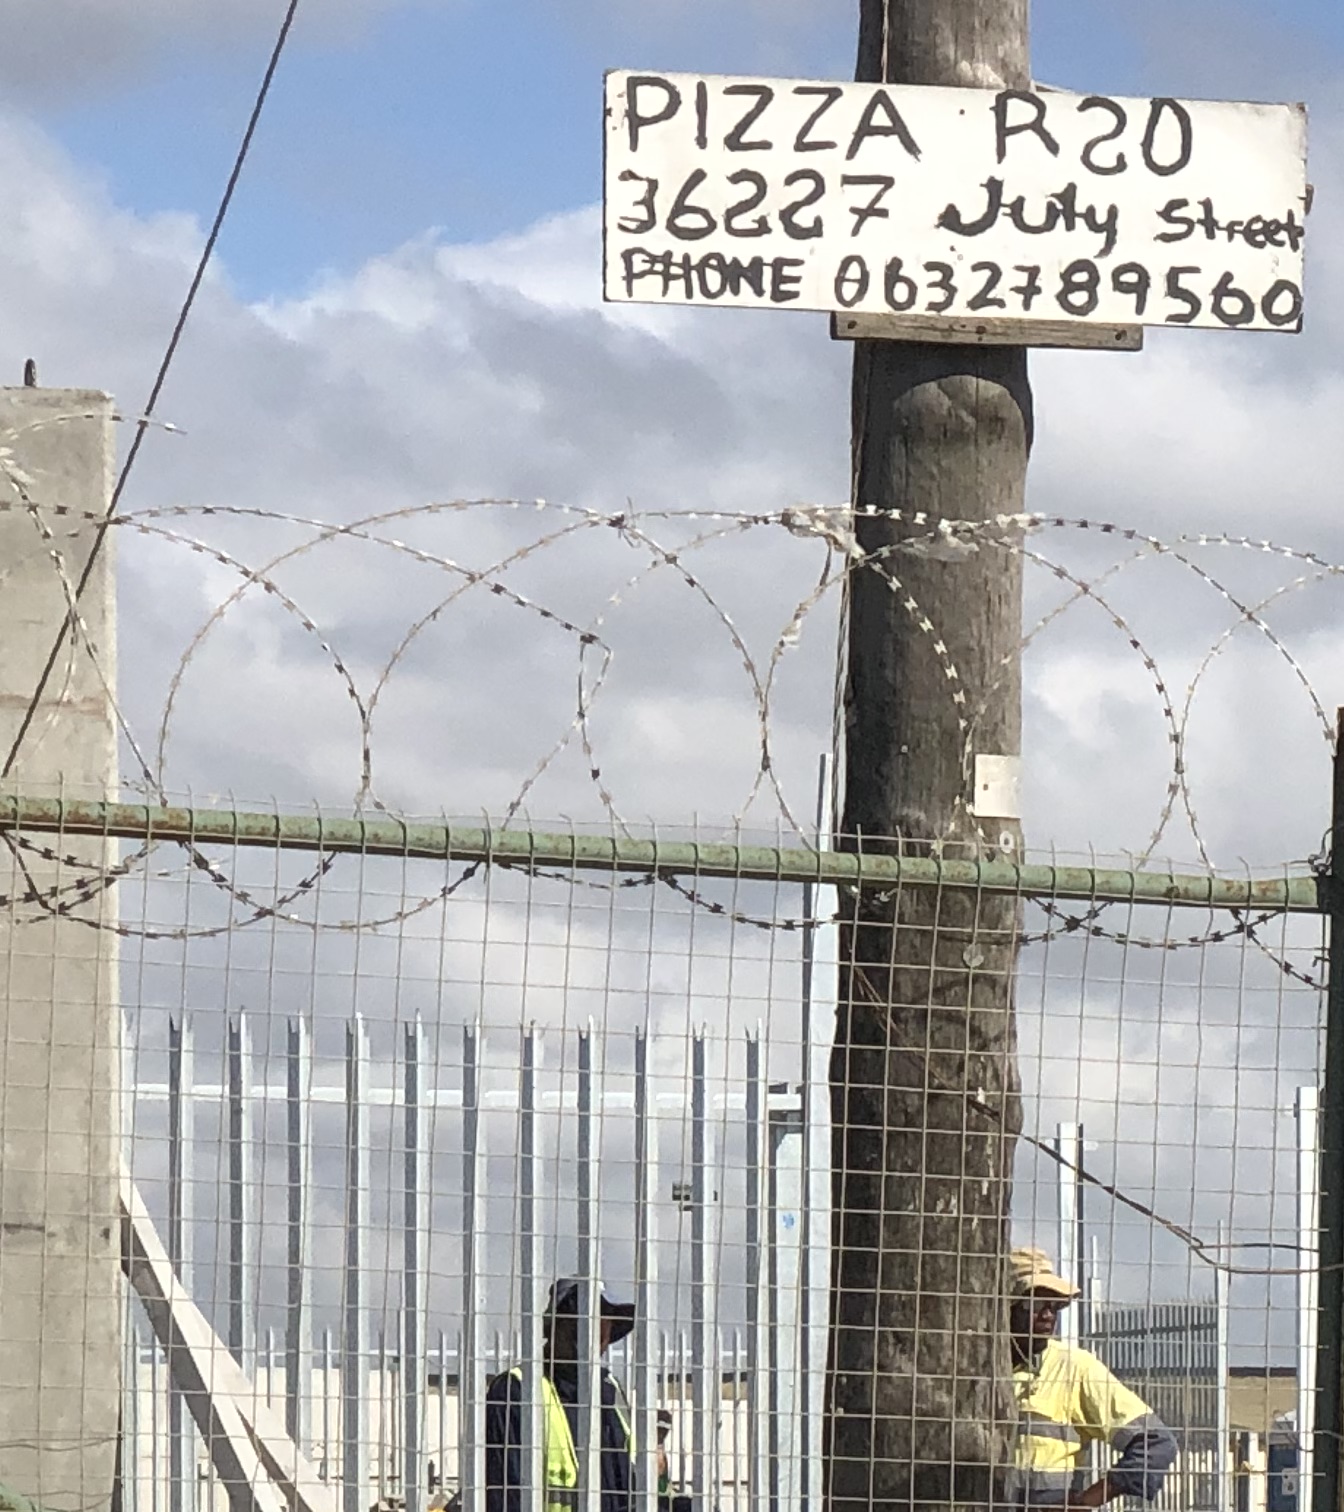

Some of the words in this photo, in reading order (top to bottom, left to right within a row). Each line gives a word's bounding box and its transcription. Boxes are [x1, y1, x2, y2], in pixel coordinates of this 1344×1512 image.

[624, 76, 924, 161] PIZZA
[990, 89, 1192, 176] R20
[618, 168, 895, 241] 36227
[936, 176, 1118, 258] July
[1154, 198, 1304, 252] Street
[621, 248, 806, 303] PHONE
[834, 254, 1302, 326] 0632789560
